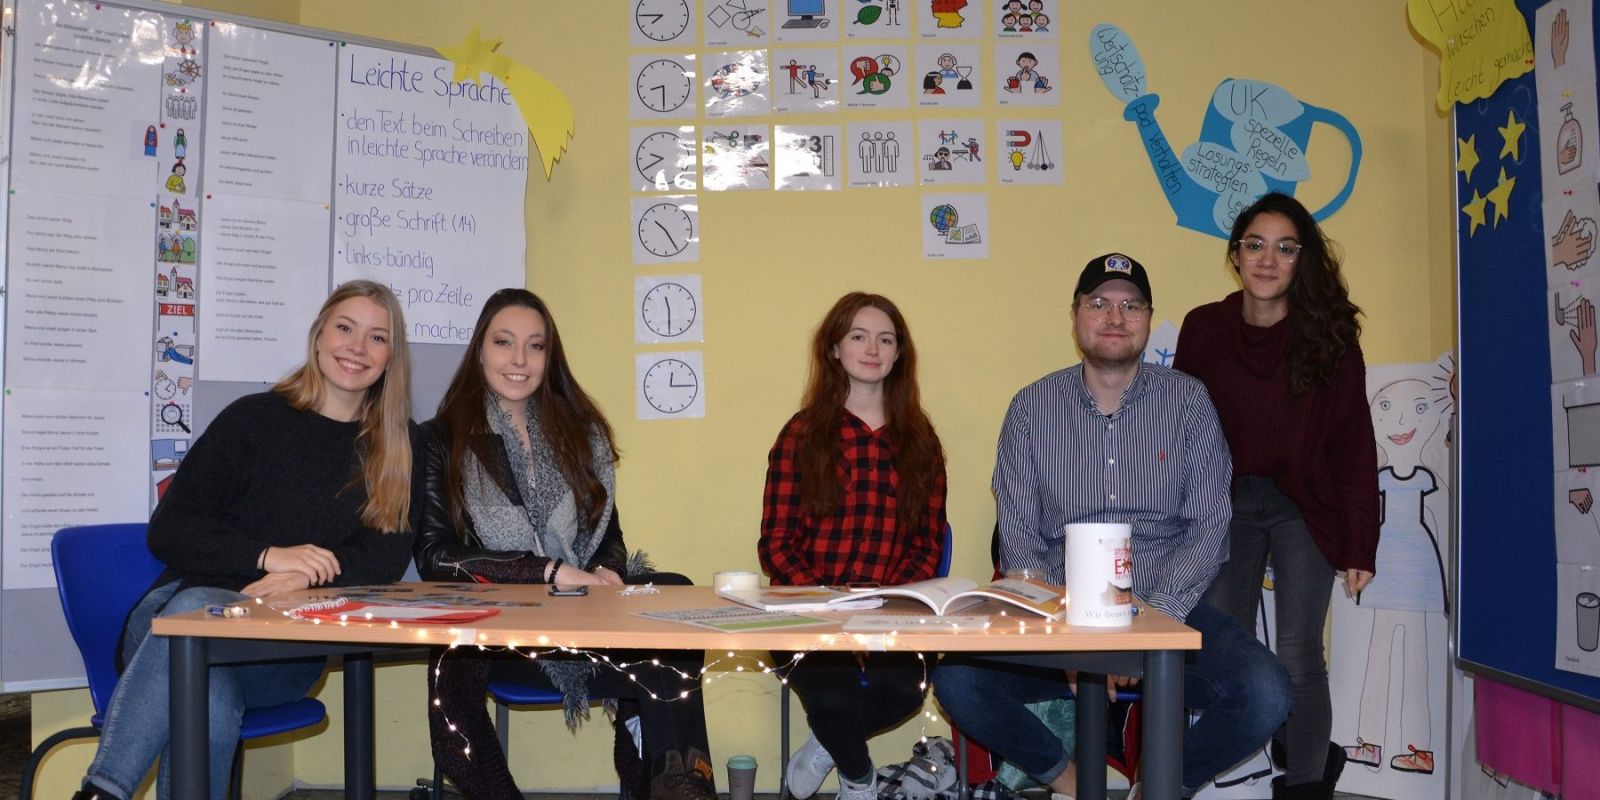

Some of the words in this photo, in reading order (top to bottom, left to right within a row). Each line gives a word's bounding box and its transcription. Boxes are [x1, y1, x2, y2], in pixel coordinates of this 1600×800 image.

[350, 53, 424, 93] Leichte
[433, 66, 512, 108] Sprache
[1230, 83, 1269, 121] UK
[346, 108, 375, 132] den
[376, 109, 407, 135] Text
[412, 112, 448, 138] beim
[451, 118, 523, 148] Schreiben
[347, 137, 360, 155] in
[361, 134, 409, 160] leichte
[413, 140, 468, 168] Sprache
[1246, 137, 1287, 177] Regeln
[345, 174, 385, 198] kurze
[391, 177, 433, 201] Sätze
[344, 206, 392, 238] große
[396, 209, 449, 233] Schrift
[451, 213, 477, 235] (14)
[166, 305, 188, 315] ZIEL
[408, 287, 434, 309] pro
[435, 282, 473, 307] Zeile
[414, 319, 475, 341] machen
